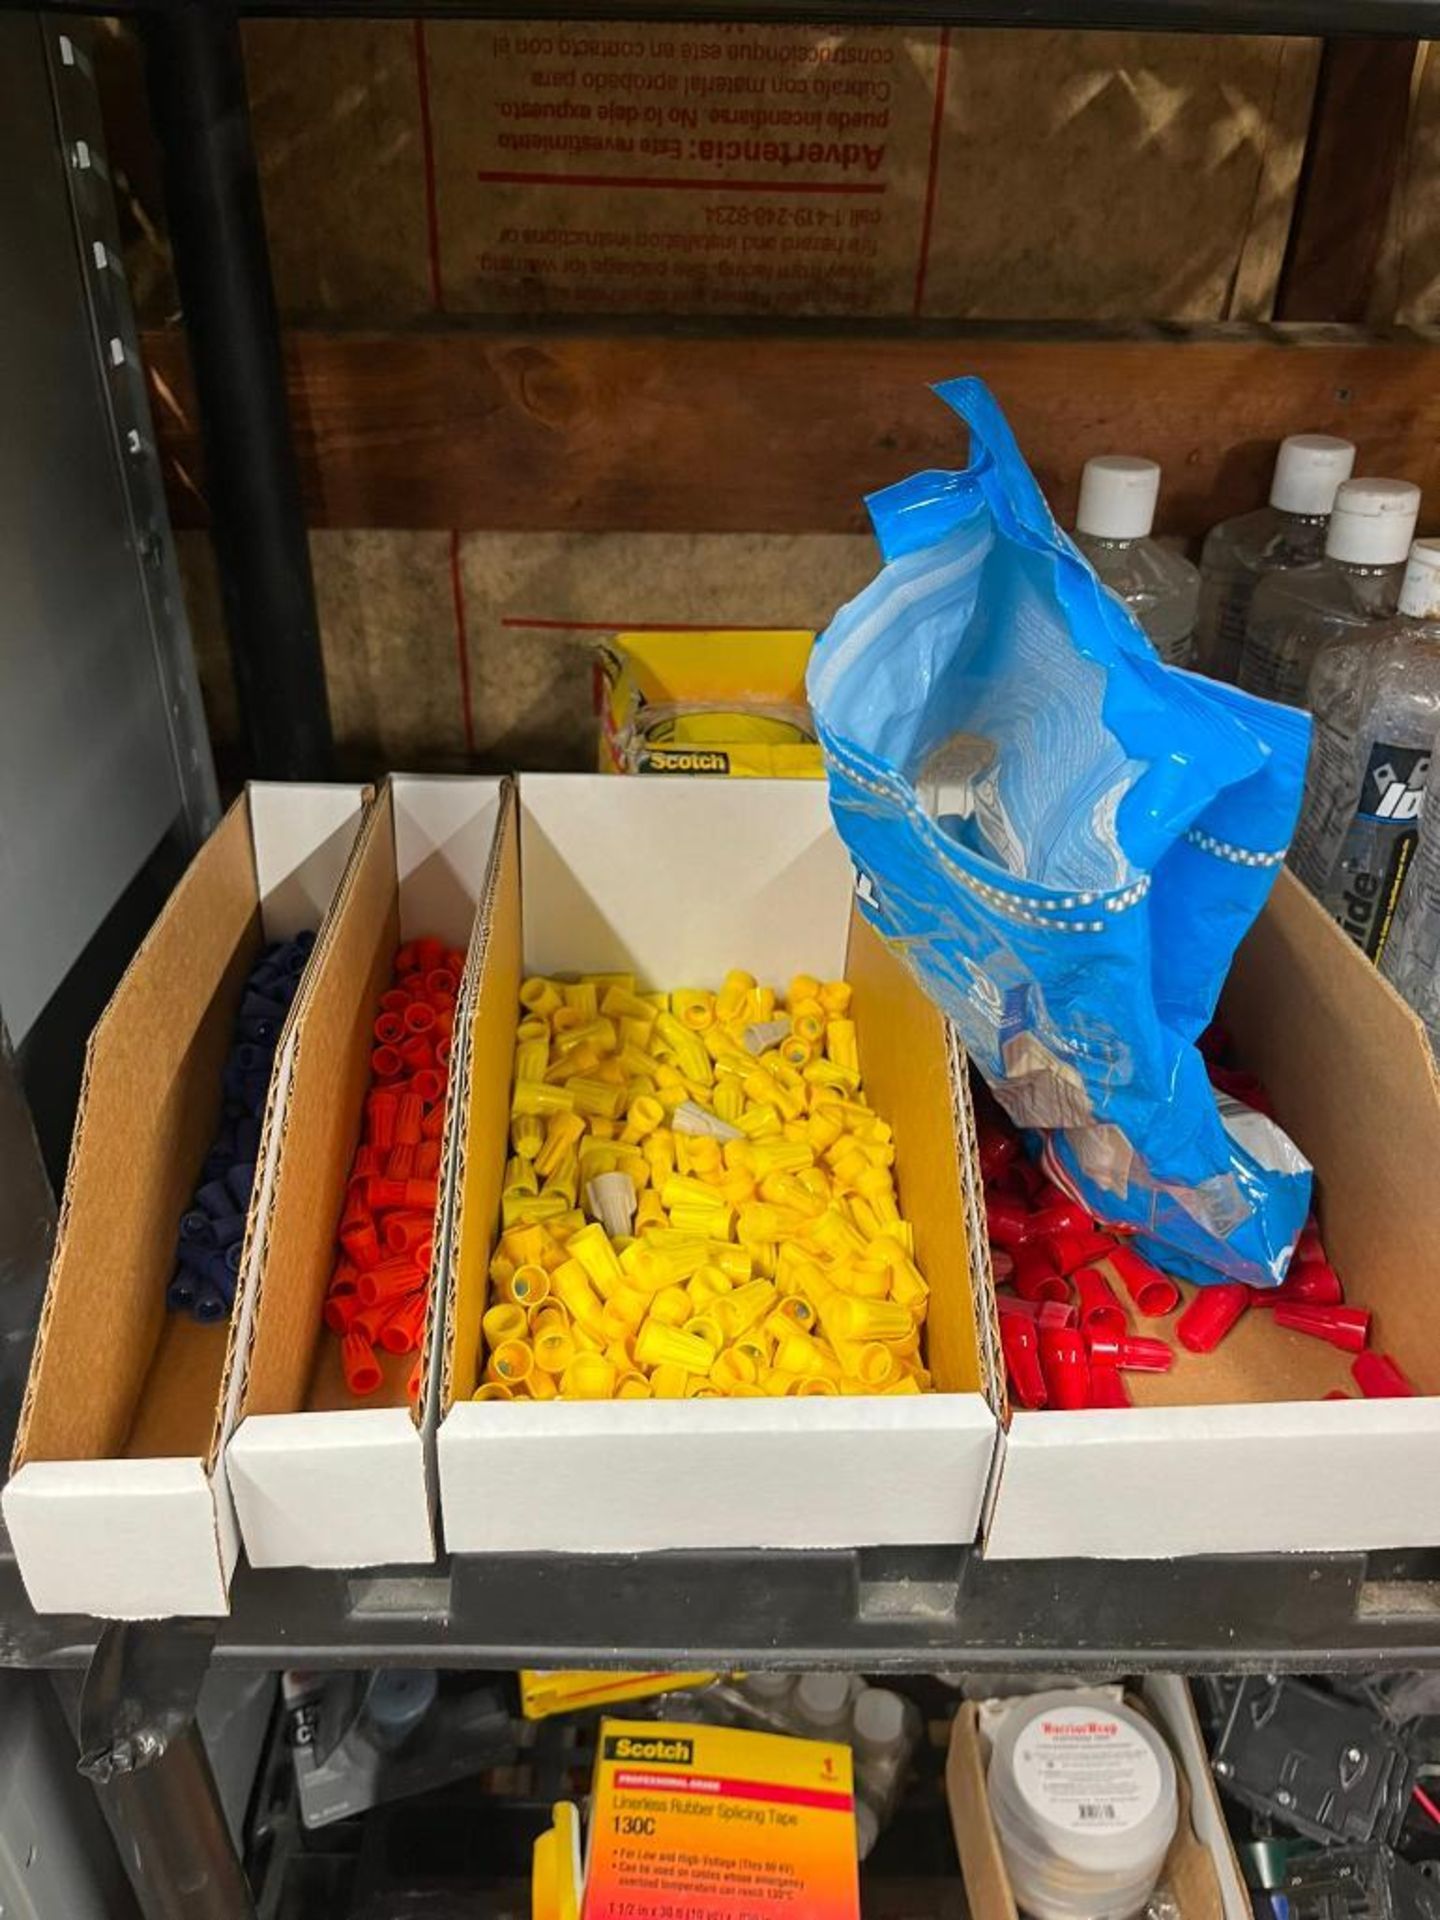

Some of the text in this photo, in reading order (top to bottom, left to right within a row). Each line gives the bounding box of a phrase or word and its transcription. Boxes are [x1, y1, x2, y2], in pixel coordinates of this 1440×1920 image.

[515, 38, 555, 57] con
[558, 39, 645, 60] contacto
[650, 42, 675, 59] en
[530, 70, 577, 89] para
[581, 71, 679, 93] aprobado
[684, 75, 766, 99] material
[771, 76, 808, 95] con
[494, 98, 593, 120] expuesto.
[597, 101, 640, 127] deje
[645, 107, 663, 127] lo
[667, 106, 699, 128] No
[826, 109, 891, 132] puede
[497, 133, 886, 172] Advertencia: Este revestimiento
[849, 207, 882, 227] call
[498, 229, 520, 245] or
[522, 229, 632, 252] instructions
[635, 232, 738, 253] installation
[741, 236, 778, 254] and
[780, 237, 843, 256] hazard
[562, 259, 588, 276] for
[650, 753, 725, 769] Scotch
[616, 1739, 689, 1761] Scotch
[823, 1757, 833, 1774] 1
[613, 1794, 798, 1827] Linerless Rubber Splicing Tape
[613, 1815, 656, 1837] 130C
[619, 1847, 636, 1861] For
[638, 1849, 657, 1862] Low
[659, 1851, 676, 1862] and
[618, 1861, 636, 1873] Can
[639, 1863, 651, 1874] be
[653, 1865, 675, 1877] used
[678, 1868, 690, 1878] on
[691, 1868, 721, 1881] cables
[724, 1871, 752, 1884] whose
[661, 1878, 717, 1894] temperature
[719, 1885, 736, 1896] can
[738, 1885, 764, 1898] reach
[618, 1902, 635, 1915] 1/2
